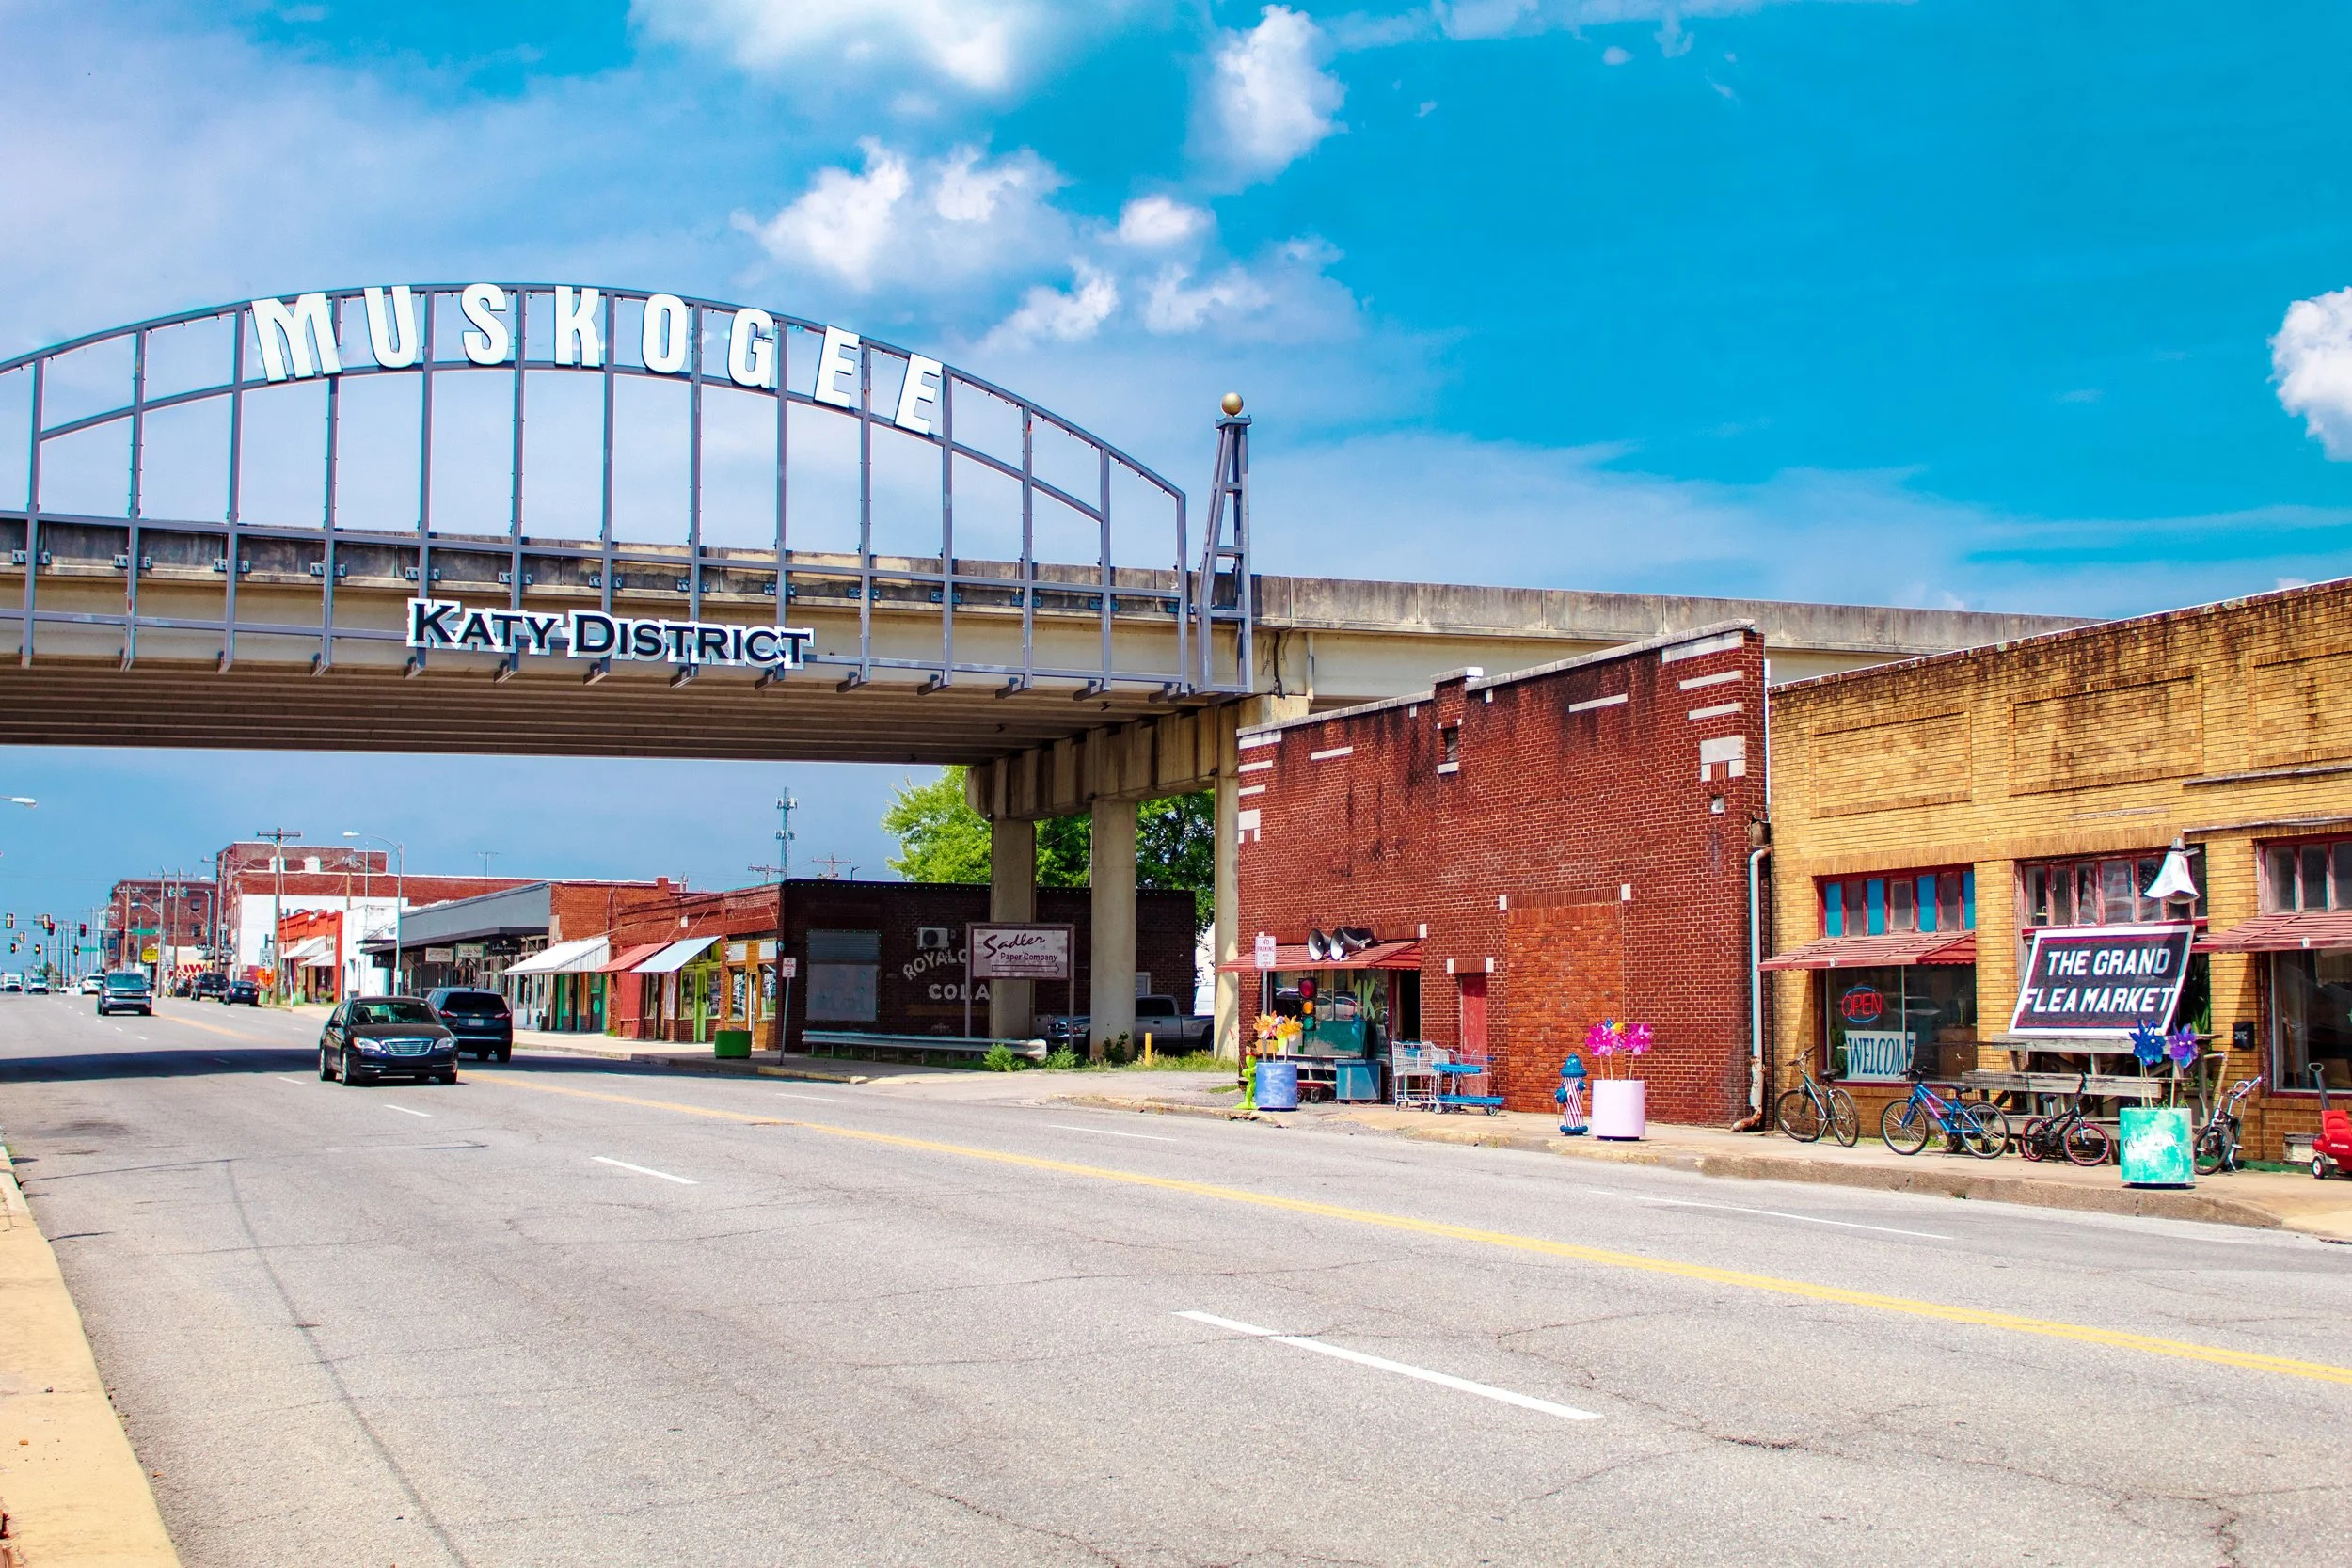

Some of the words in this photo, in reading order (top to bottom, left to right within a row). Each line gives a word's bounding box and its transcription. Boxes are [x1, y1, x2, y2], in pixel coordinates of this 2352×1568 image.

[250, 283, 944, 436] MUSKOGEE
[408, 598, 563, 656] KATY
[567, 610, 814, 669] DISTRICT
[983, 933, 1046, 959] Sadler
[1000, 952, 1023, 962] Paper
[1023, 952, 1058, 963] Company
[902, 949, 957, 981] ROYAL
[2047, 949, 2091, 976] THE
[2092, 948, 2171, 976] GRAND
[928, 983, 990, 1001] COLA
[1841, 993, 1883, 1017] OPEN
[2020, 987, 2078, 1013] FLEA
[2079, 987, 2176, 1013] MARKET
[1847, 1037, 1915, 1076] WELCOME
